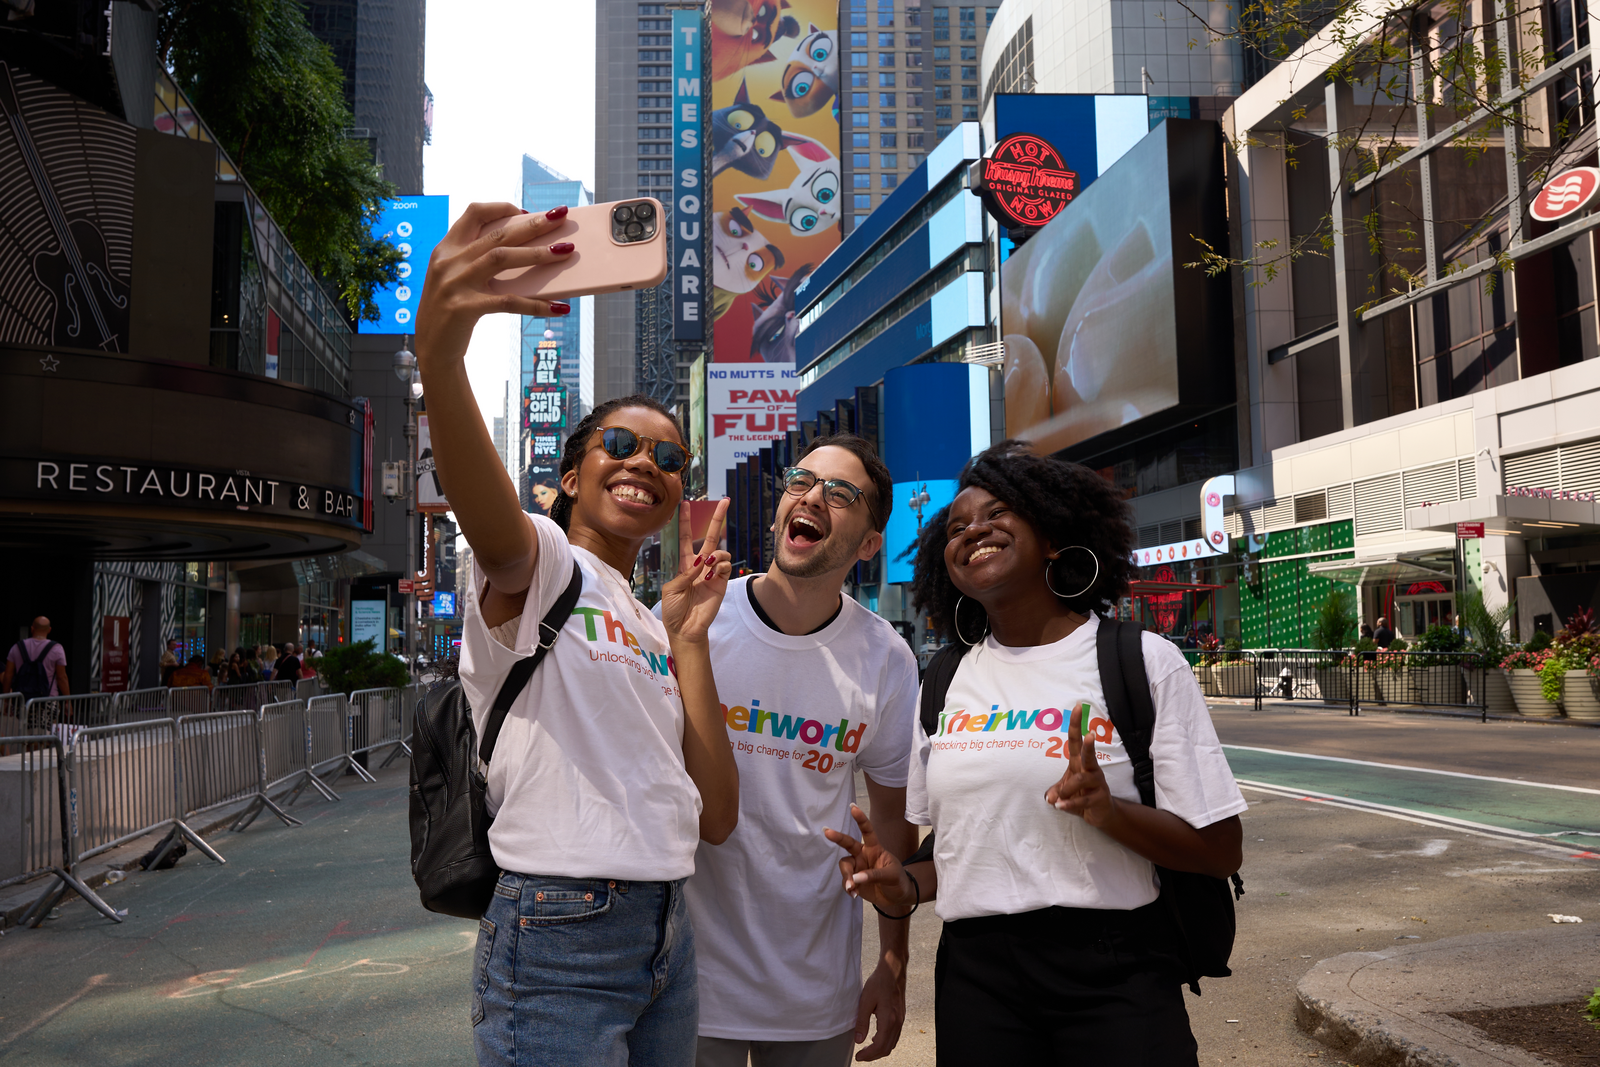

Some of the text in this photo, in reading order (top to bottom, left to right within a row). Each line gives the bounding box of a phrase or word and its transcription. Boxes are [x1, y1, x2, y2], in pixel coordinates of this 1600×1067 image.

[1009, 142, 1050, 162] HOT
[678, 27, 701, 321] TIMES SQUARE
[984, 159, 1076, 191] Krispy Kreme
[988, 182, 1073, 200] ORIGINAL GLAZED
[1009, 196, 1054, 219] NOW
[709, 371, 727, 379] NO
[730, 370, 775, 379] MUTTS
[530, 401, 548, 412] OF
[728, 389, 800, 404] PAW
[530, 406, 562, 423] MIND
[711, 413, 798, 438] FUR
[534, 446, 557, 455] NYC
[37, 462, 354, 517] RESTAURANT & BAR
[1506, 485, 1555, 500] CROWNE
[589, 649, 641, 673] Unlocking
[720, 699, 867, 754] eirworld
[969, 740, 984, 752] big
[986, 739, 1024, 750] change
[1028, 738, 1045, 749] for
[737, 741, 754, 754] big
[757, 744, 790, 760] change
[792, 750, 805, 761] for
[802, 749, 834, 774] 20
